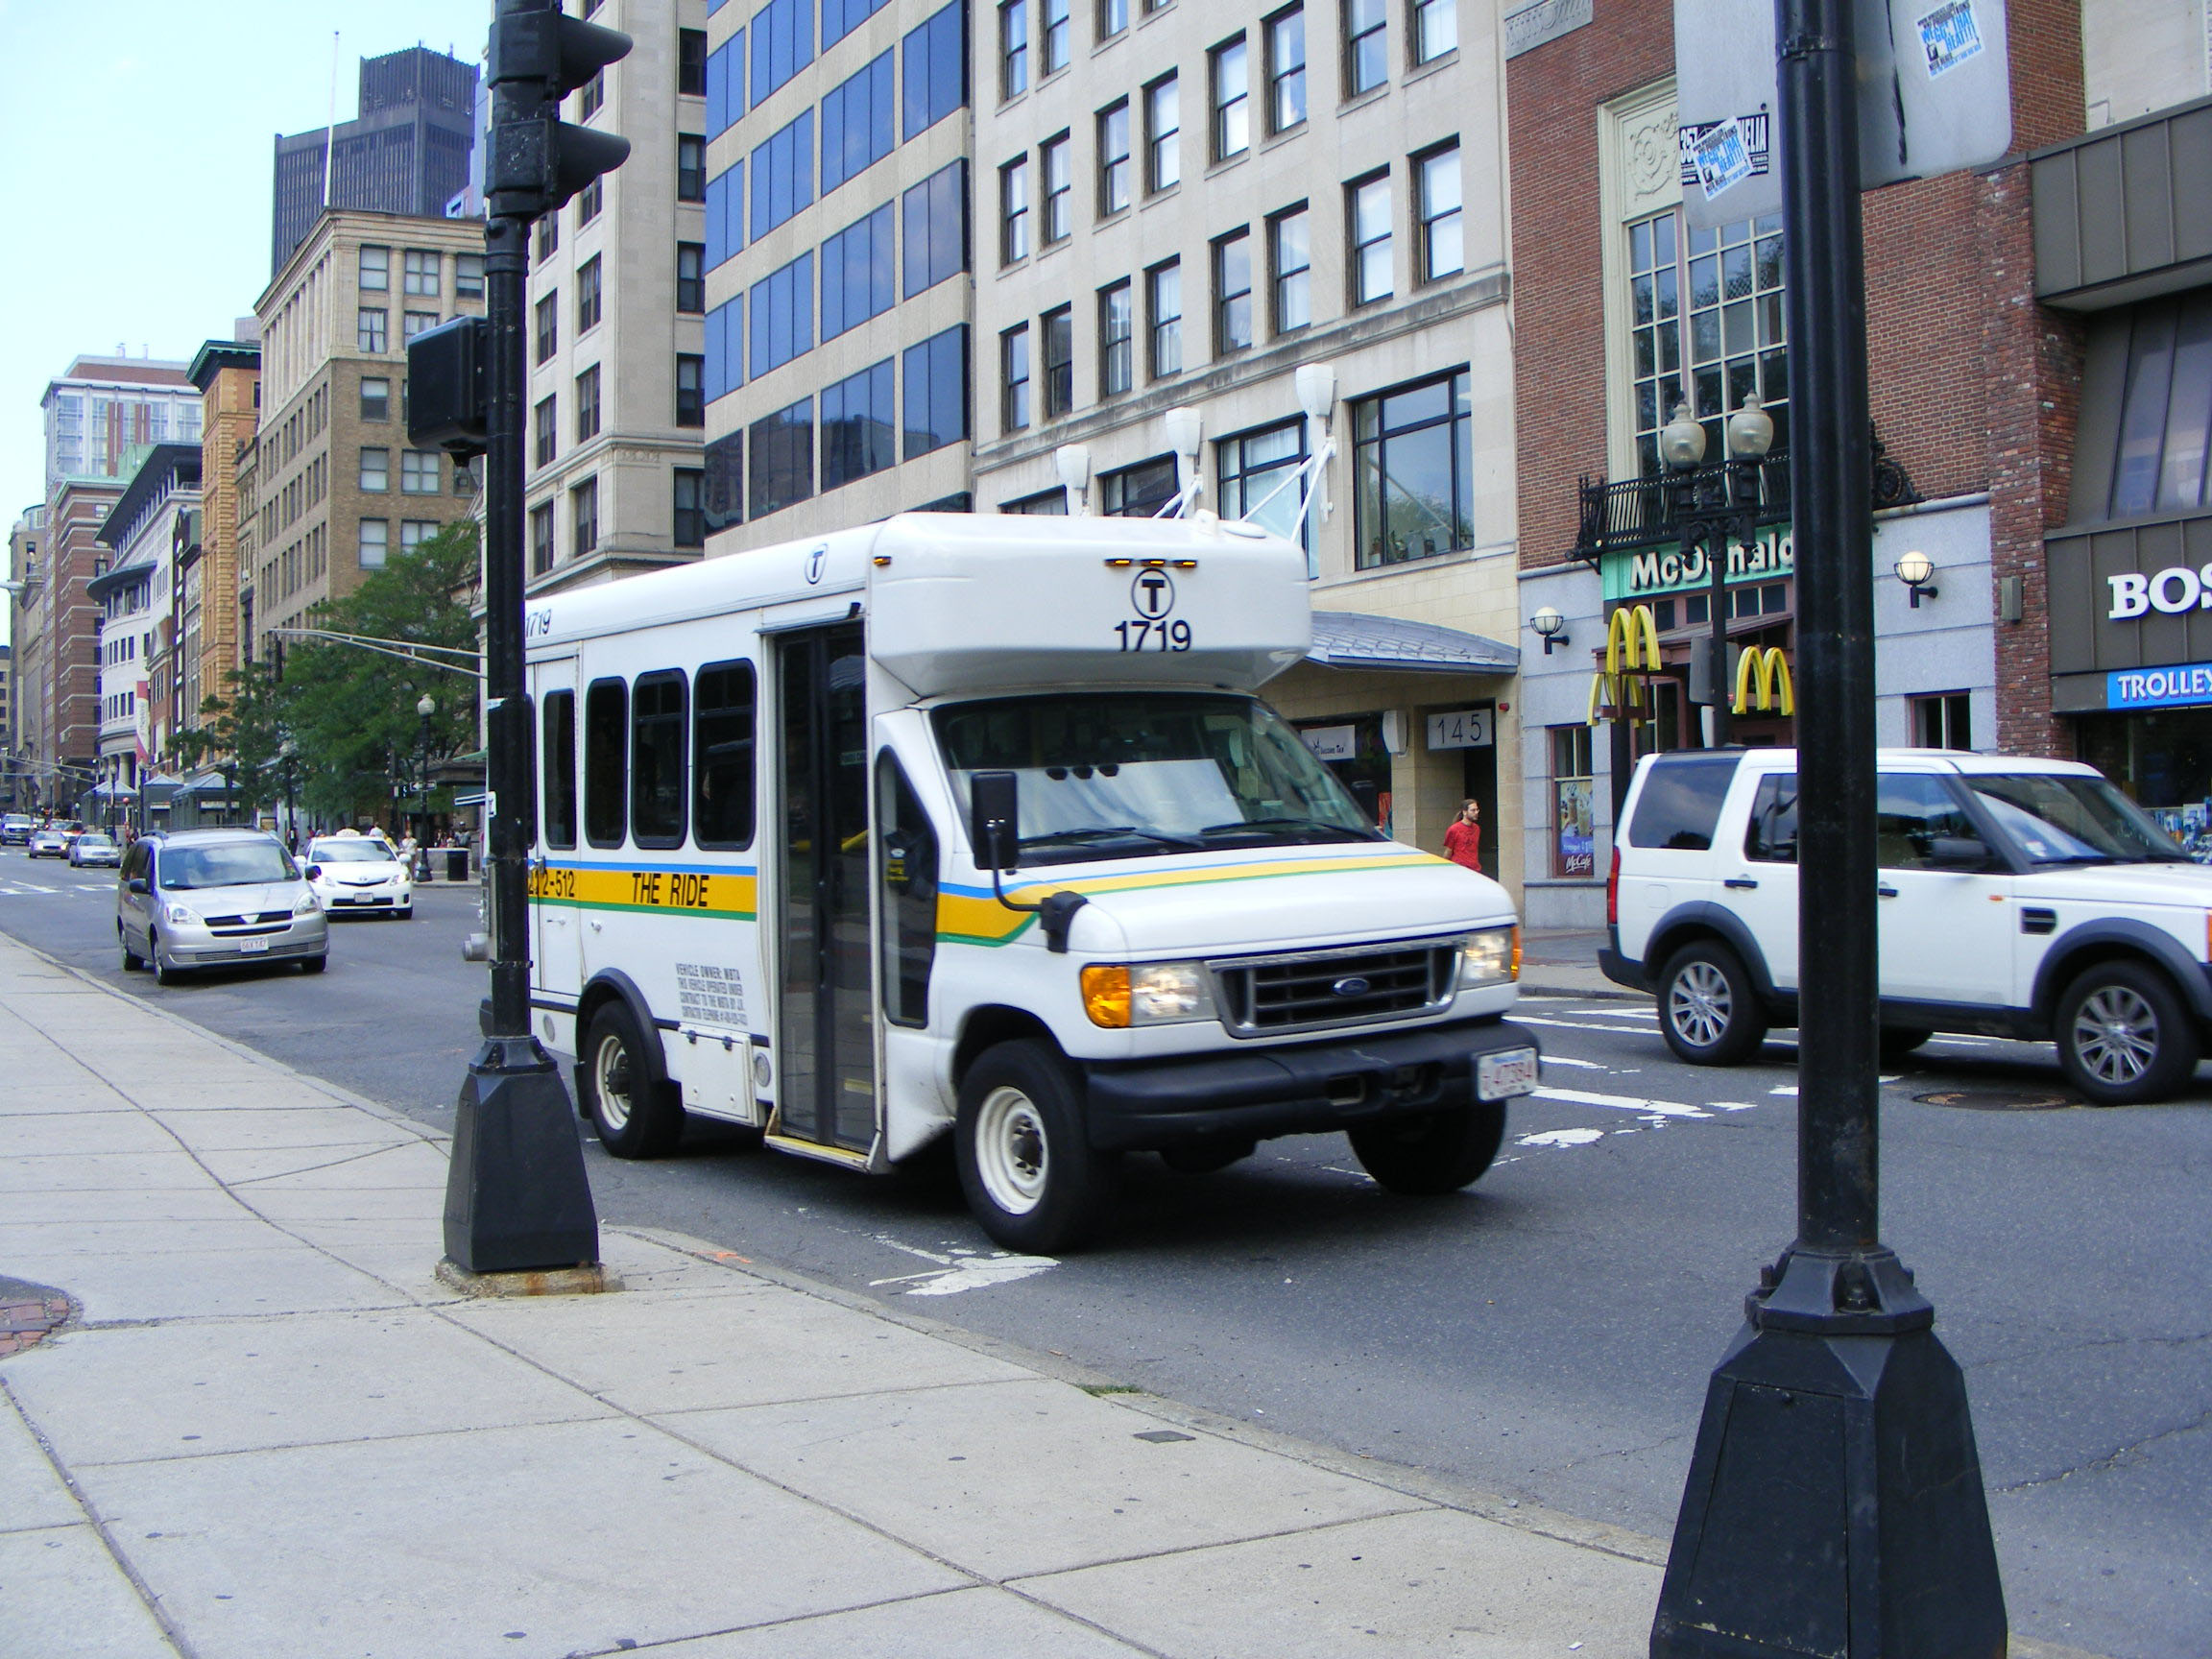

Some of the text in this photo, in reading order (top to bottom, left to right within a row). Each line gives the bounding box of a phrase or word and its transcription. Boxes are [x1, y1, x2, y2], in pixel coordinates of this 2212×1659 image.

[1142, 579, 1165, 613] T
[525, 608, 552, 637] 1719
[1114, 620, 1191, 652] 1719
[1438, 714, 1482, 744] 145
[632, 872, 661, 904] THE
[669, 874, 709, 907] RIDE
